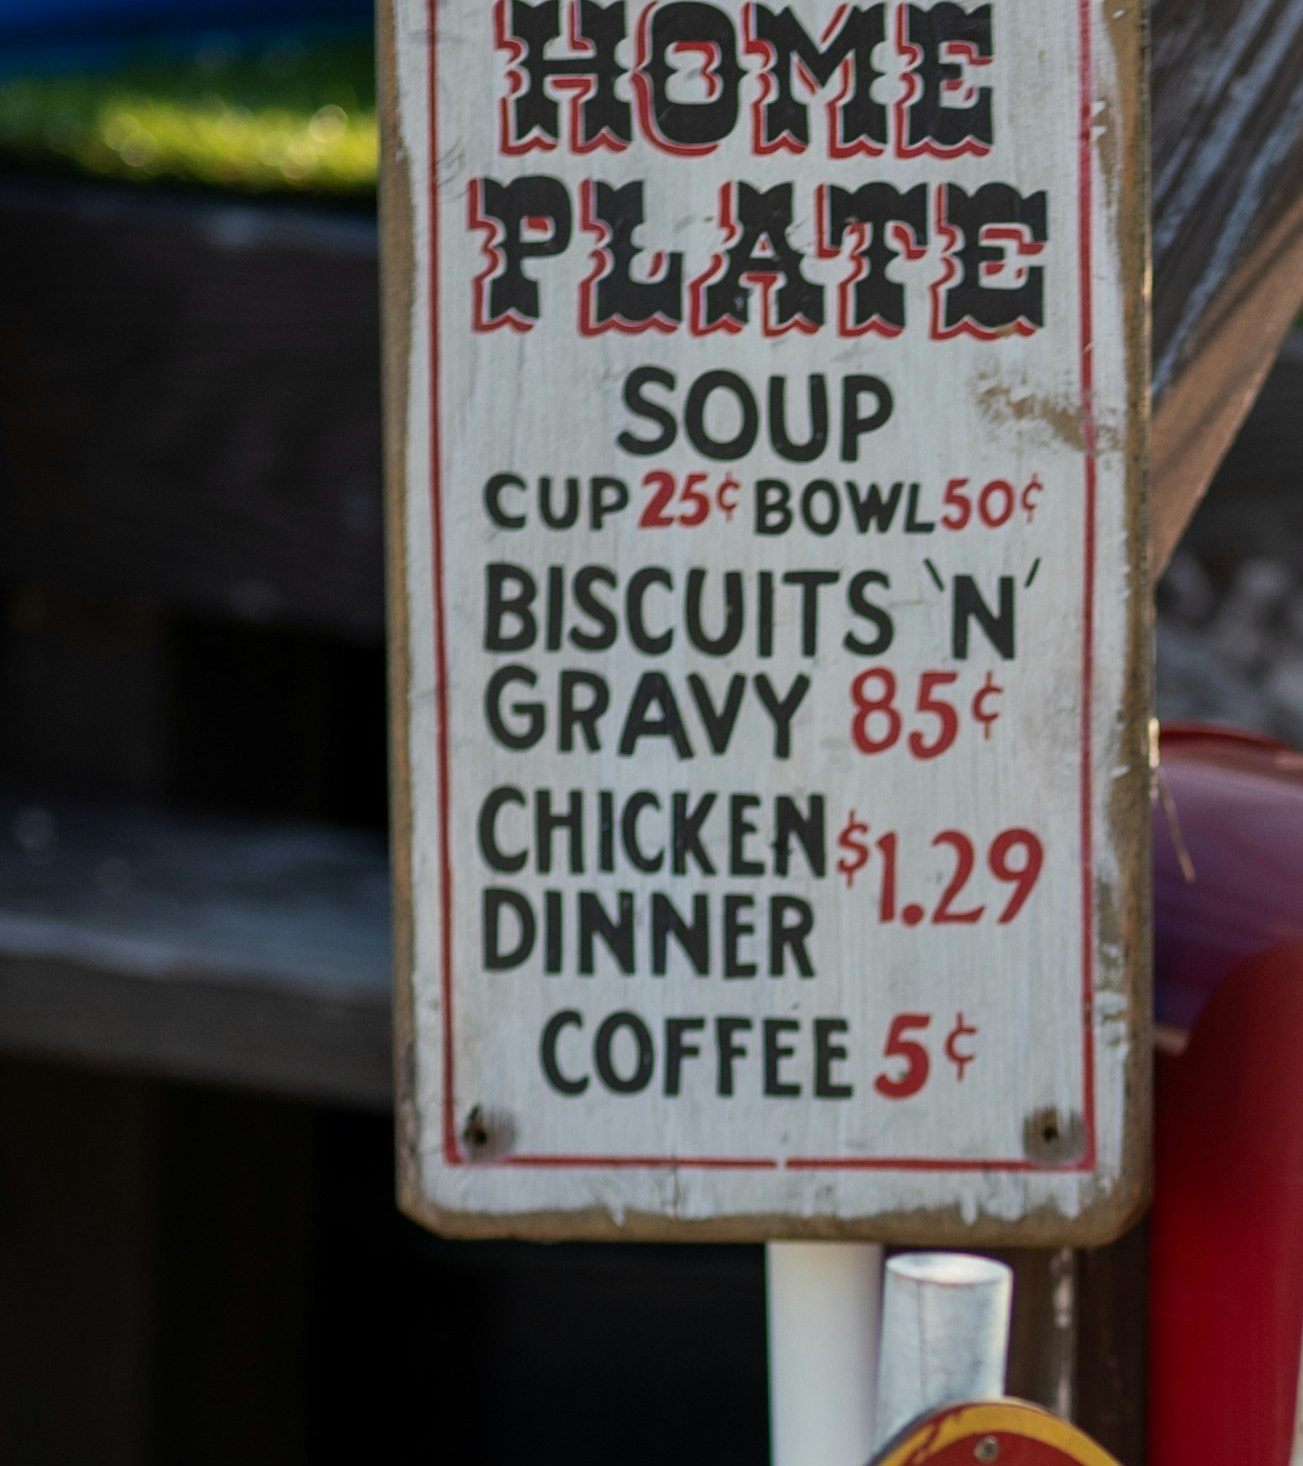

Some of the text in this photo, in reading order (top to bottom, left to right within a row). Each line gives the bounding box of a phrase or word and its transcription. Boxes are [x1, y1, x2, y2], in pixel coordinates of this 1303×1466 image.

[467, 174, 1049, 342] PLATE
[615, 364, 893, 463] SOUP
[483, 469, 1044, 537] CUP 25¢ BOWL 50¢
[483, 561, 895, 661] BISCUITS
[484, 664, 1004, 761] GRAVY 85¢
[477, 786, 1045, 929] CHICKEN $1.29
[481, 886, 818, 980] DINNER
[540, 1009, 979, 1101] COFFEE 5¢
